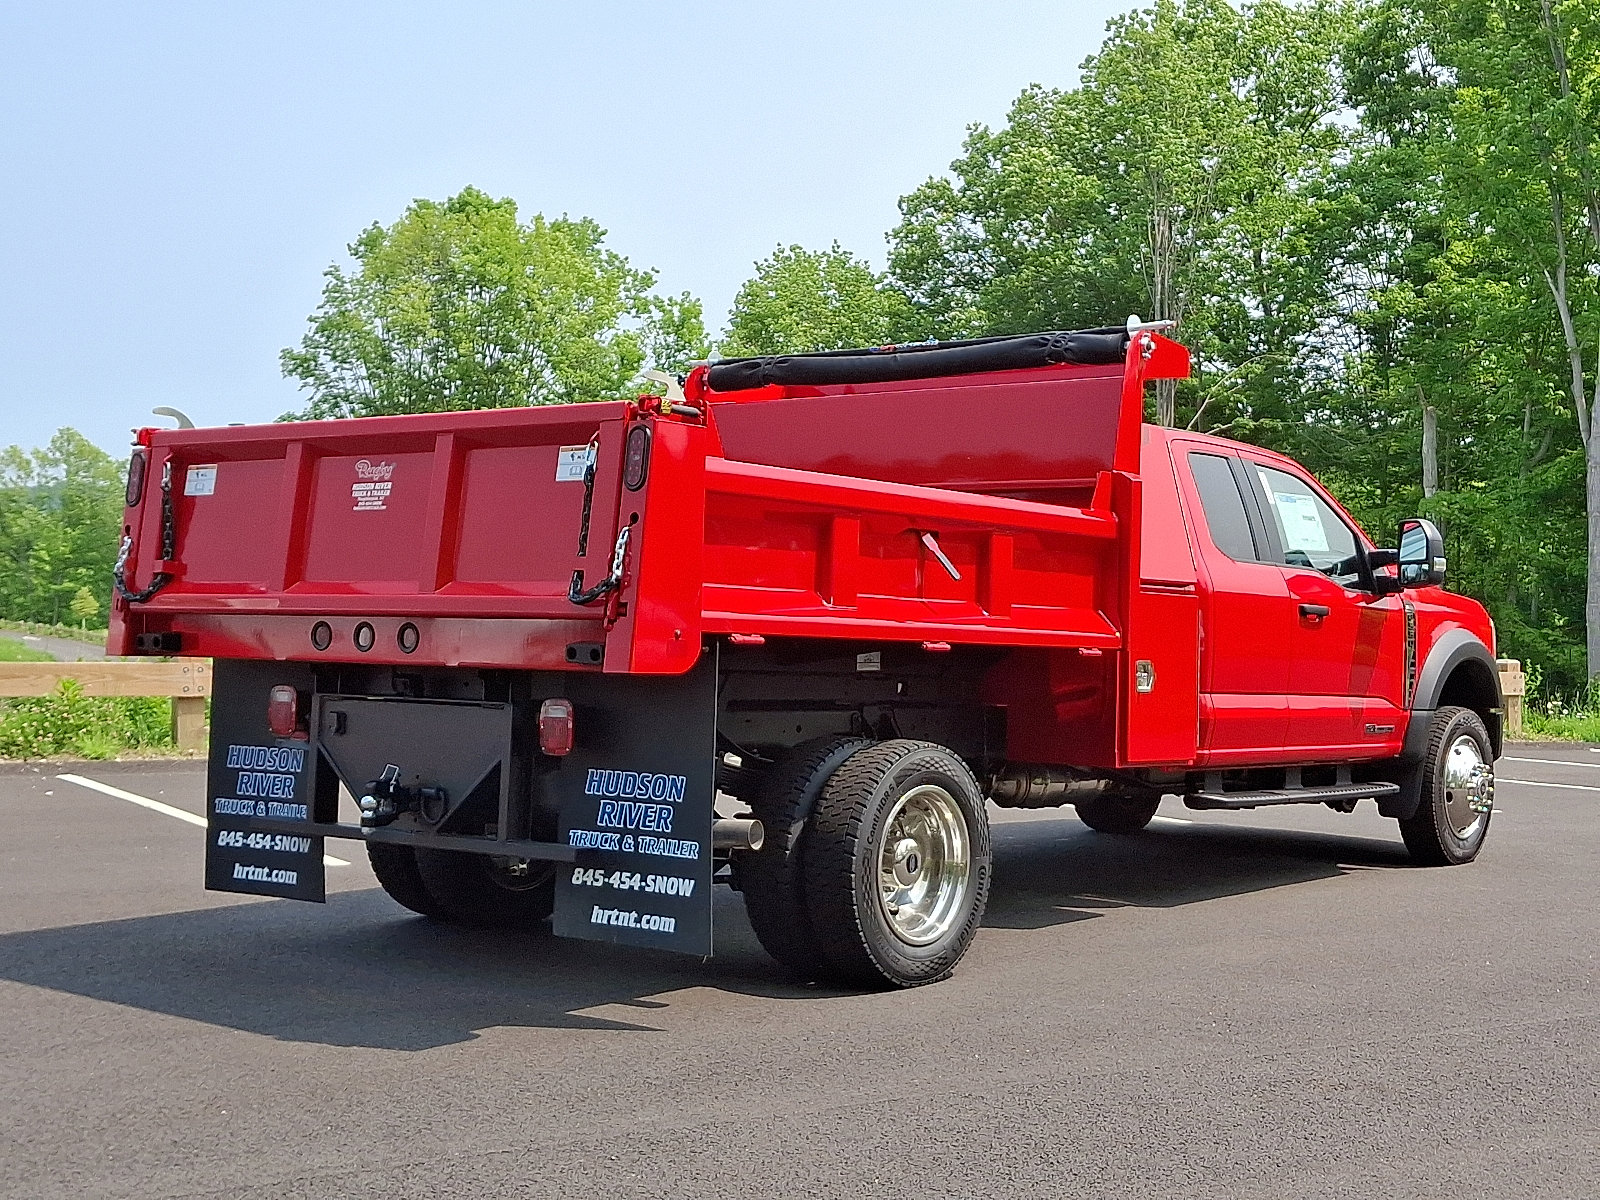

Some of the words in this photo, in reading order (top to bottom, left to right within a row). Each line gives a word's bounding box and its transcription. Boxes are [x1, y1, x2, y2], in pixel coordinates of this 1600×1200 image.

[355, 460, 394, 480] Rugby
[226, 744, 304, 773] HUDSON
[236, 771, 295, 798] RIVER
[585, 768, 687, 802] HUDSON
[214, 797, 256, 816] TRUCK
[255, 800, 266, 816] &
[268, 801, 308, 820] TRAILE
[597, 799, 674, 832] RIVER
[217, 830, 312, 853] 845-454-SNOW
[569, 829, 619, 851] TRUCK
[622, 834, 634, 851] &
[638, 835, 700, 859] TRAILER
[232, 862, 298, 885] hrtnt.com
[571, 867, 696, 897] 845-454-SNOW
[590, 905, 676, 933] hrtnt.com
